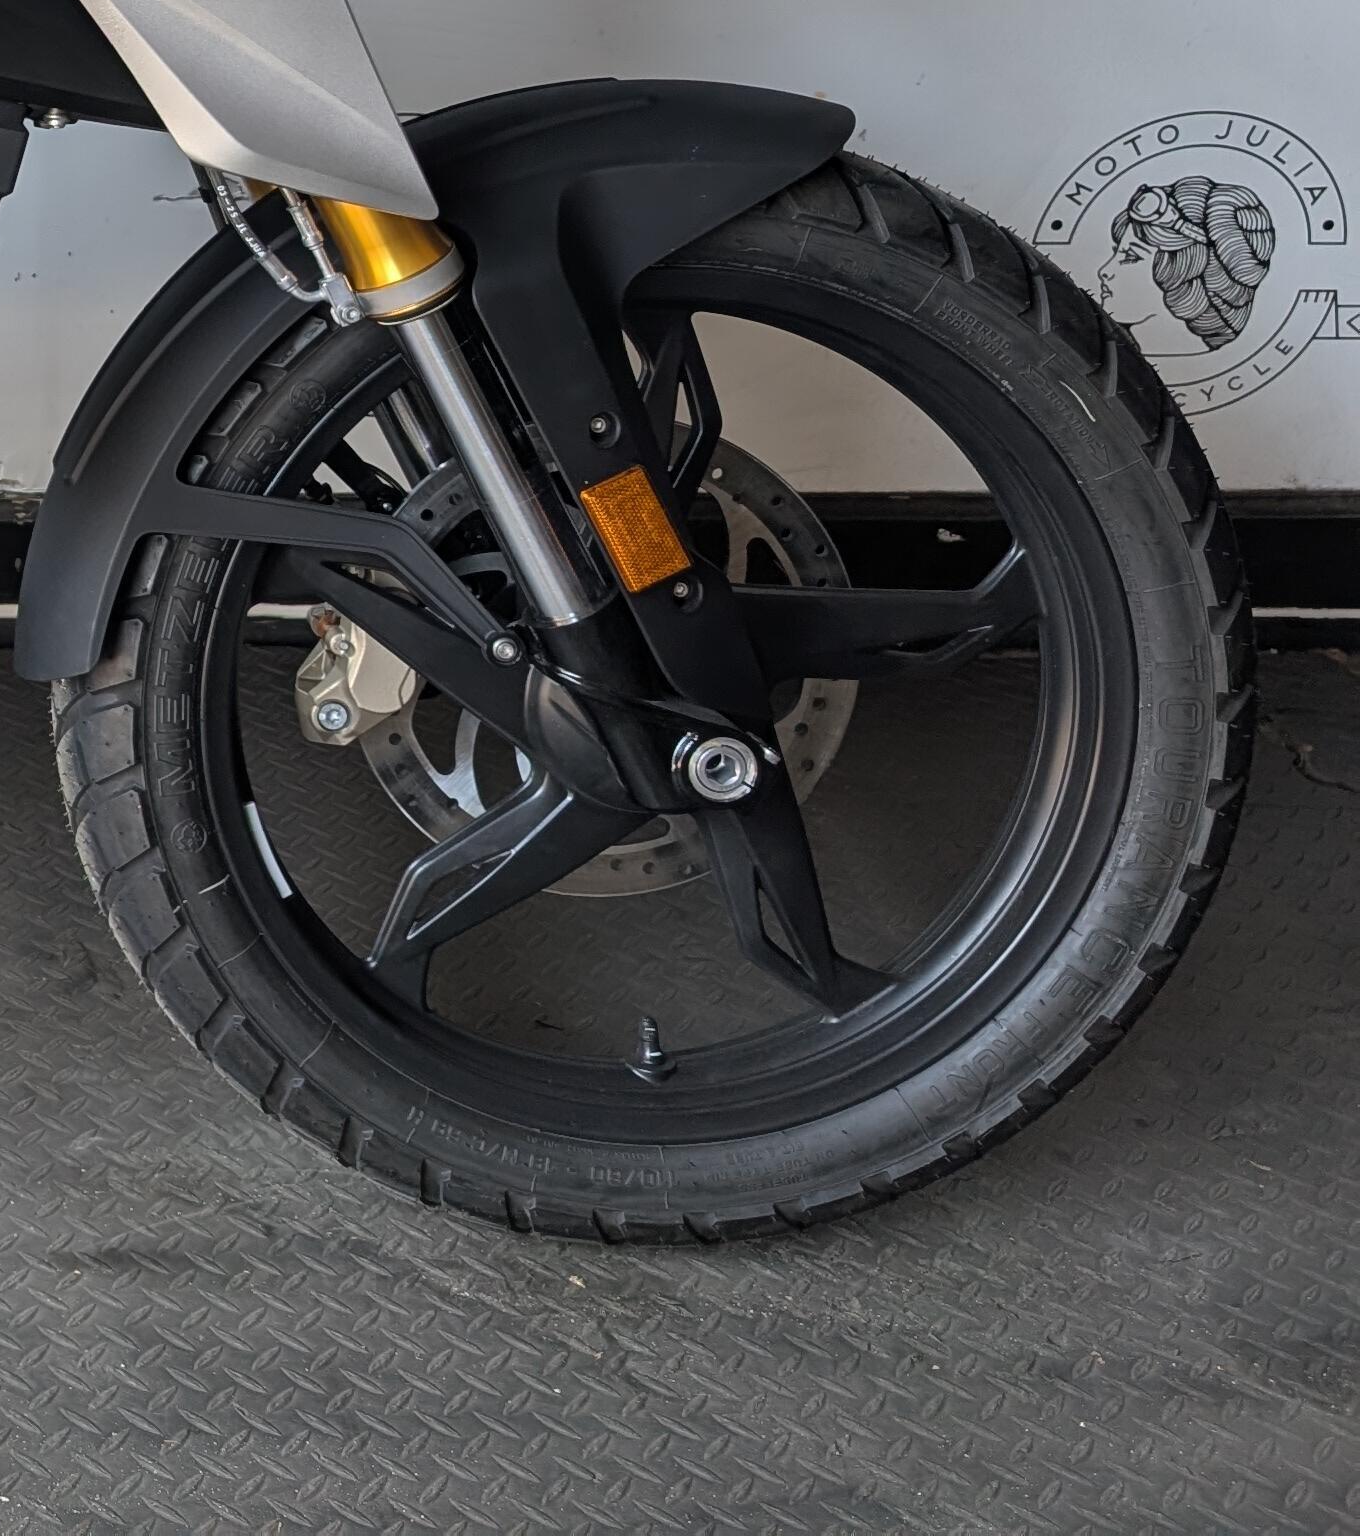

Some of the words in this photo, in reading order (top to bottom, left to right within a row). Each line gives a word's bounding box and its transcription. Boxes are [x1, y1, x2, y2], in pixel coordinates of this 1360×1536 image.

[1065, 124, 1179, 206] MOTO
[1215, 120, 1327, 206] JULIA
[154, 425, 287, 797] METZEER
